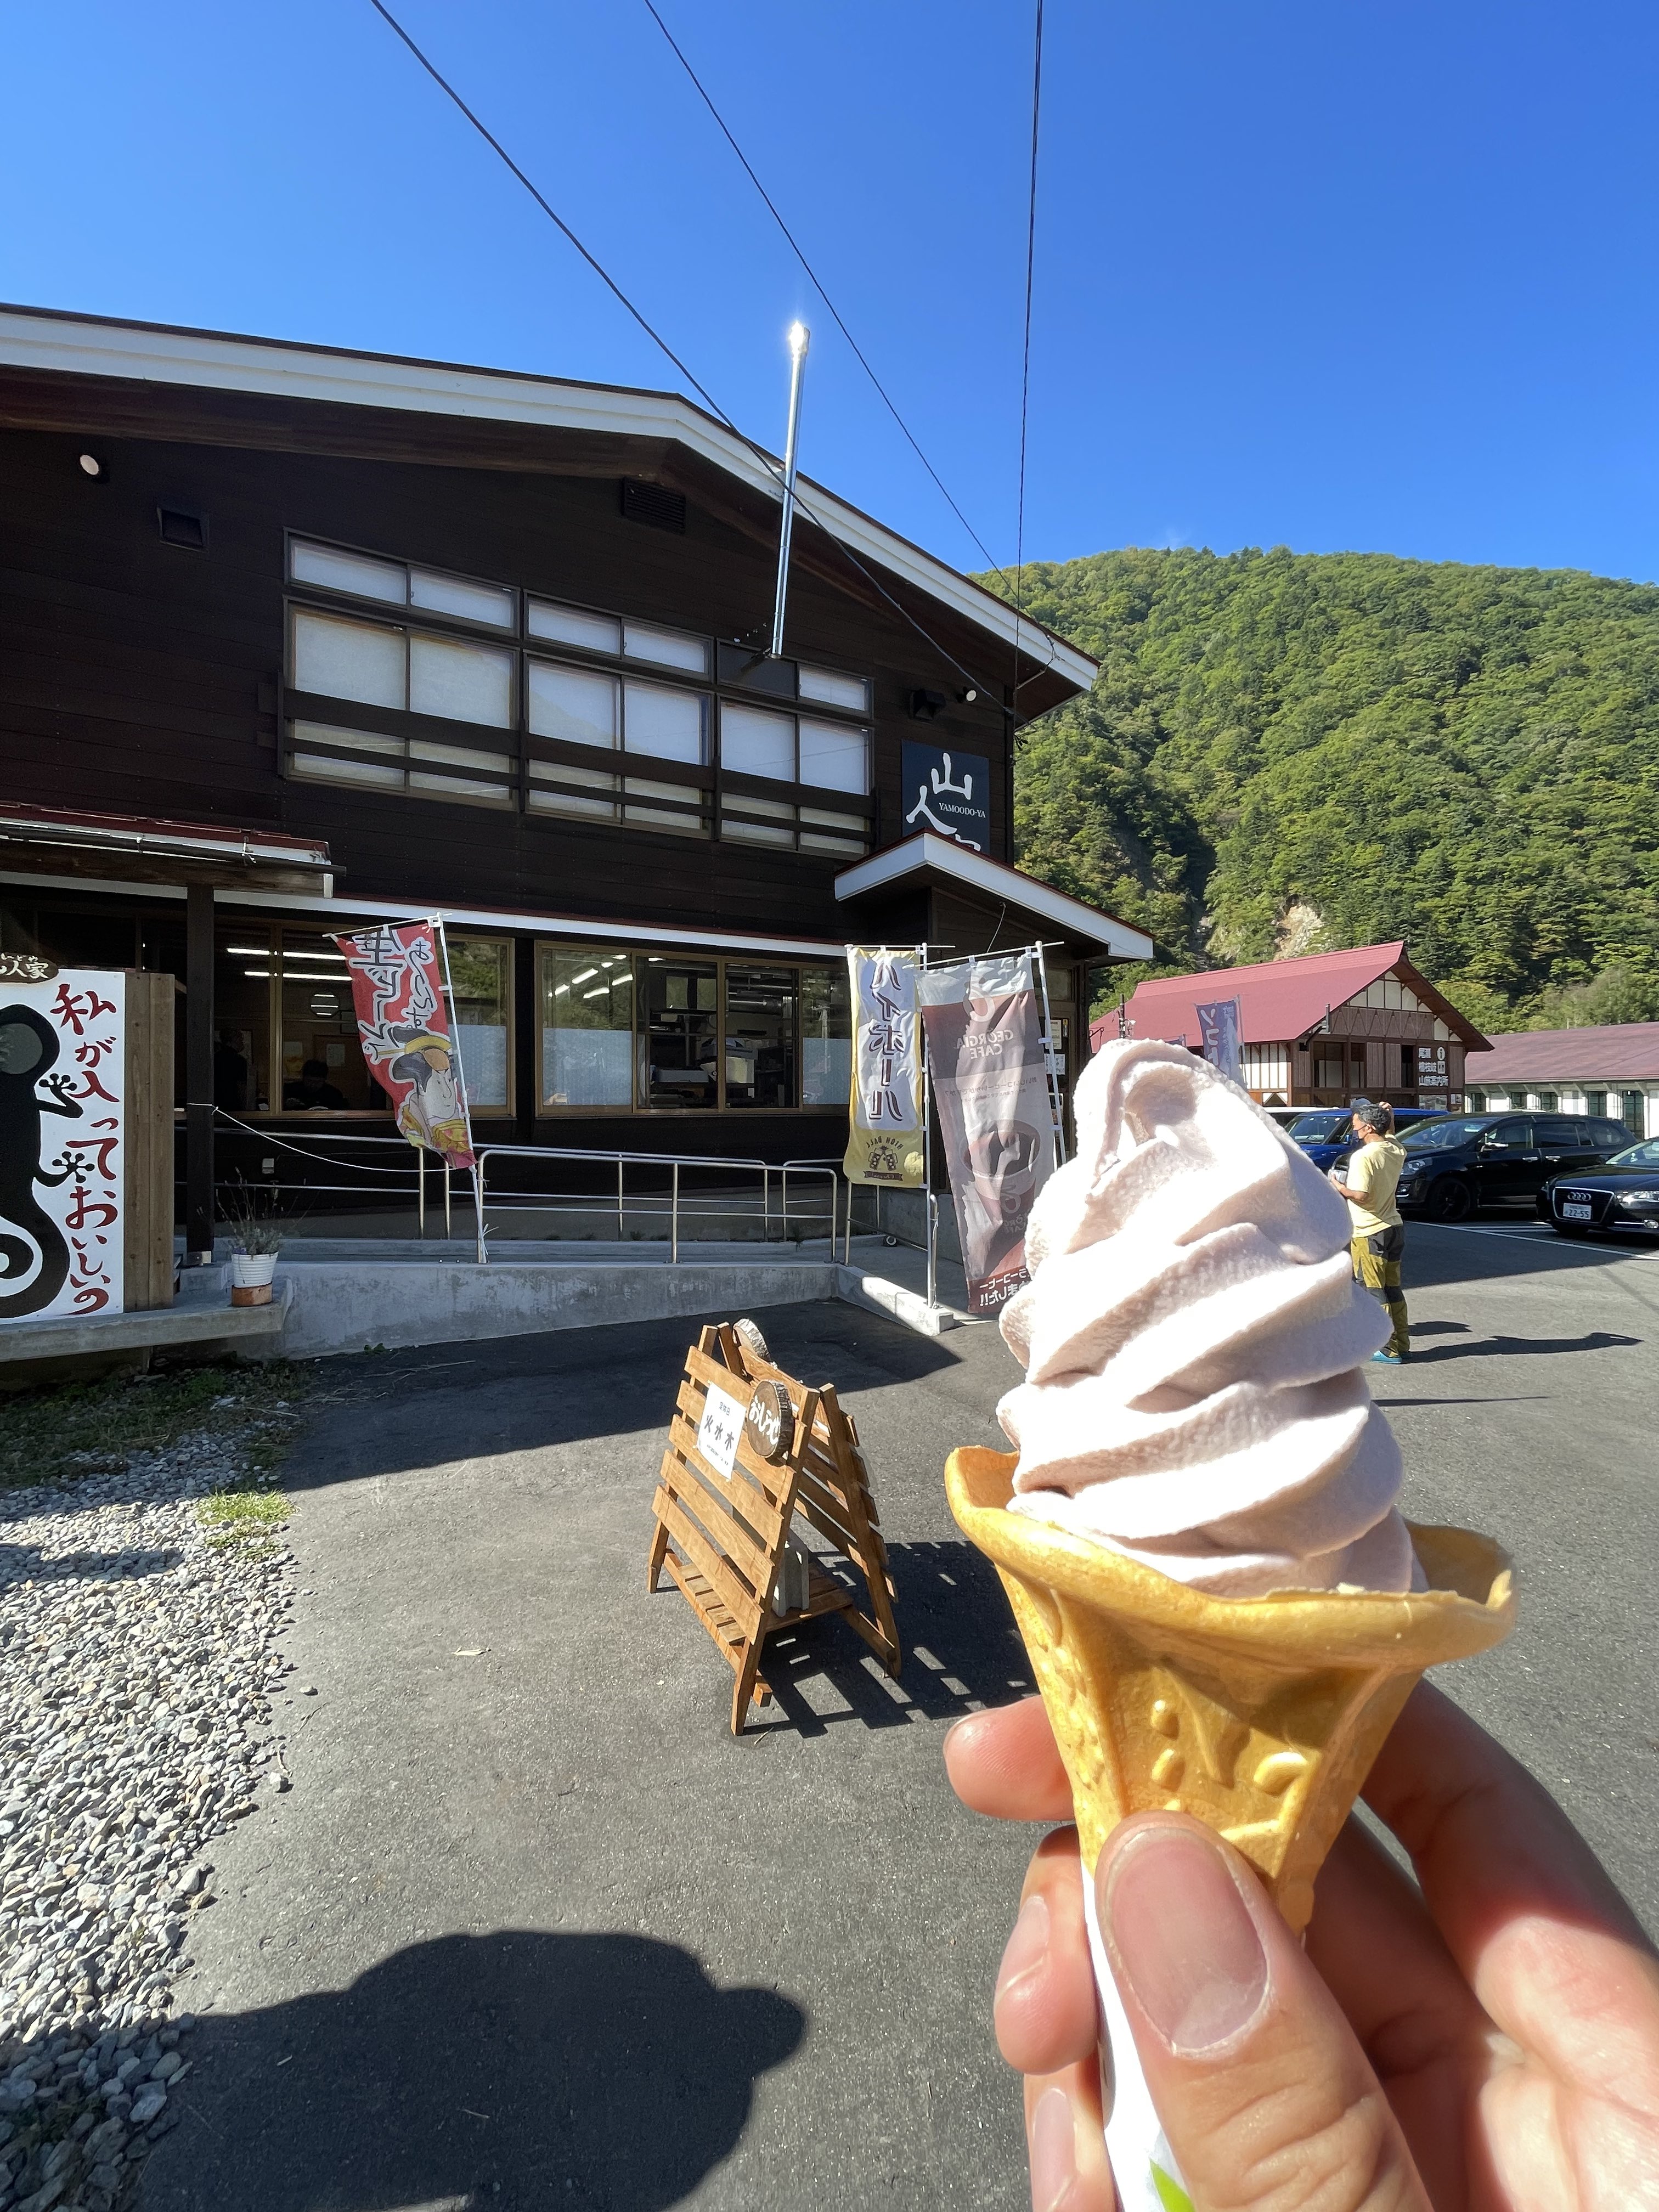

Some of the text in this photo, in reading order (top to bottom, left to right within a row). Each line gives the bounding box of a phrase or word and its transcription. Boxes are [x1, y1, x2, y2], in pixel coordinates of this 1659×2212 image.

[906, 752, 981, 852] 山人
[939, 802, 986, 818] YAMOODO-YA
[50, 983, 120, 1316] 私が入っておいしいの
